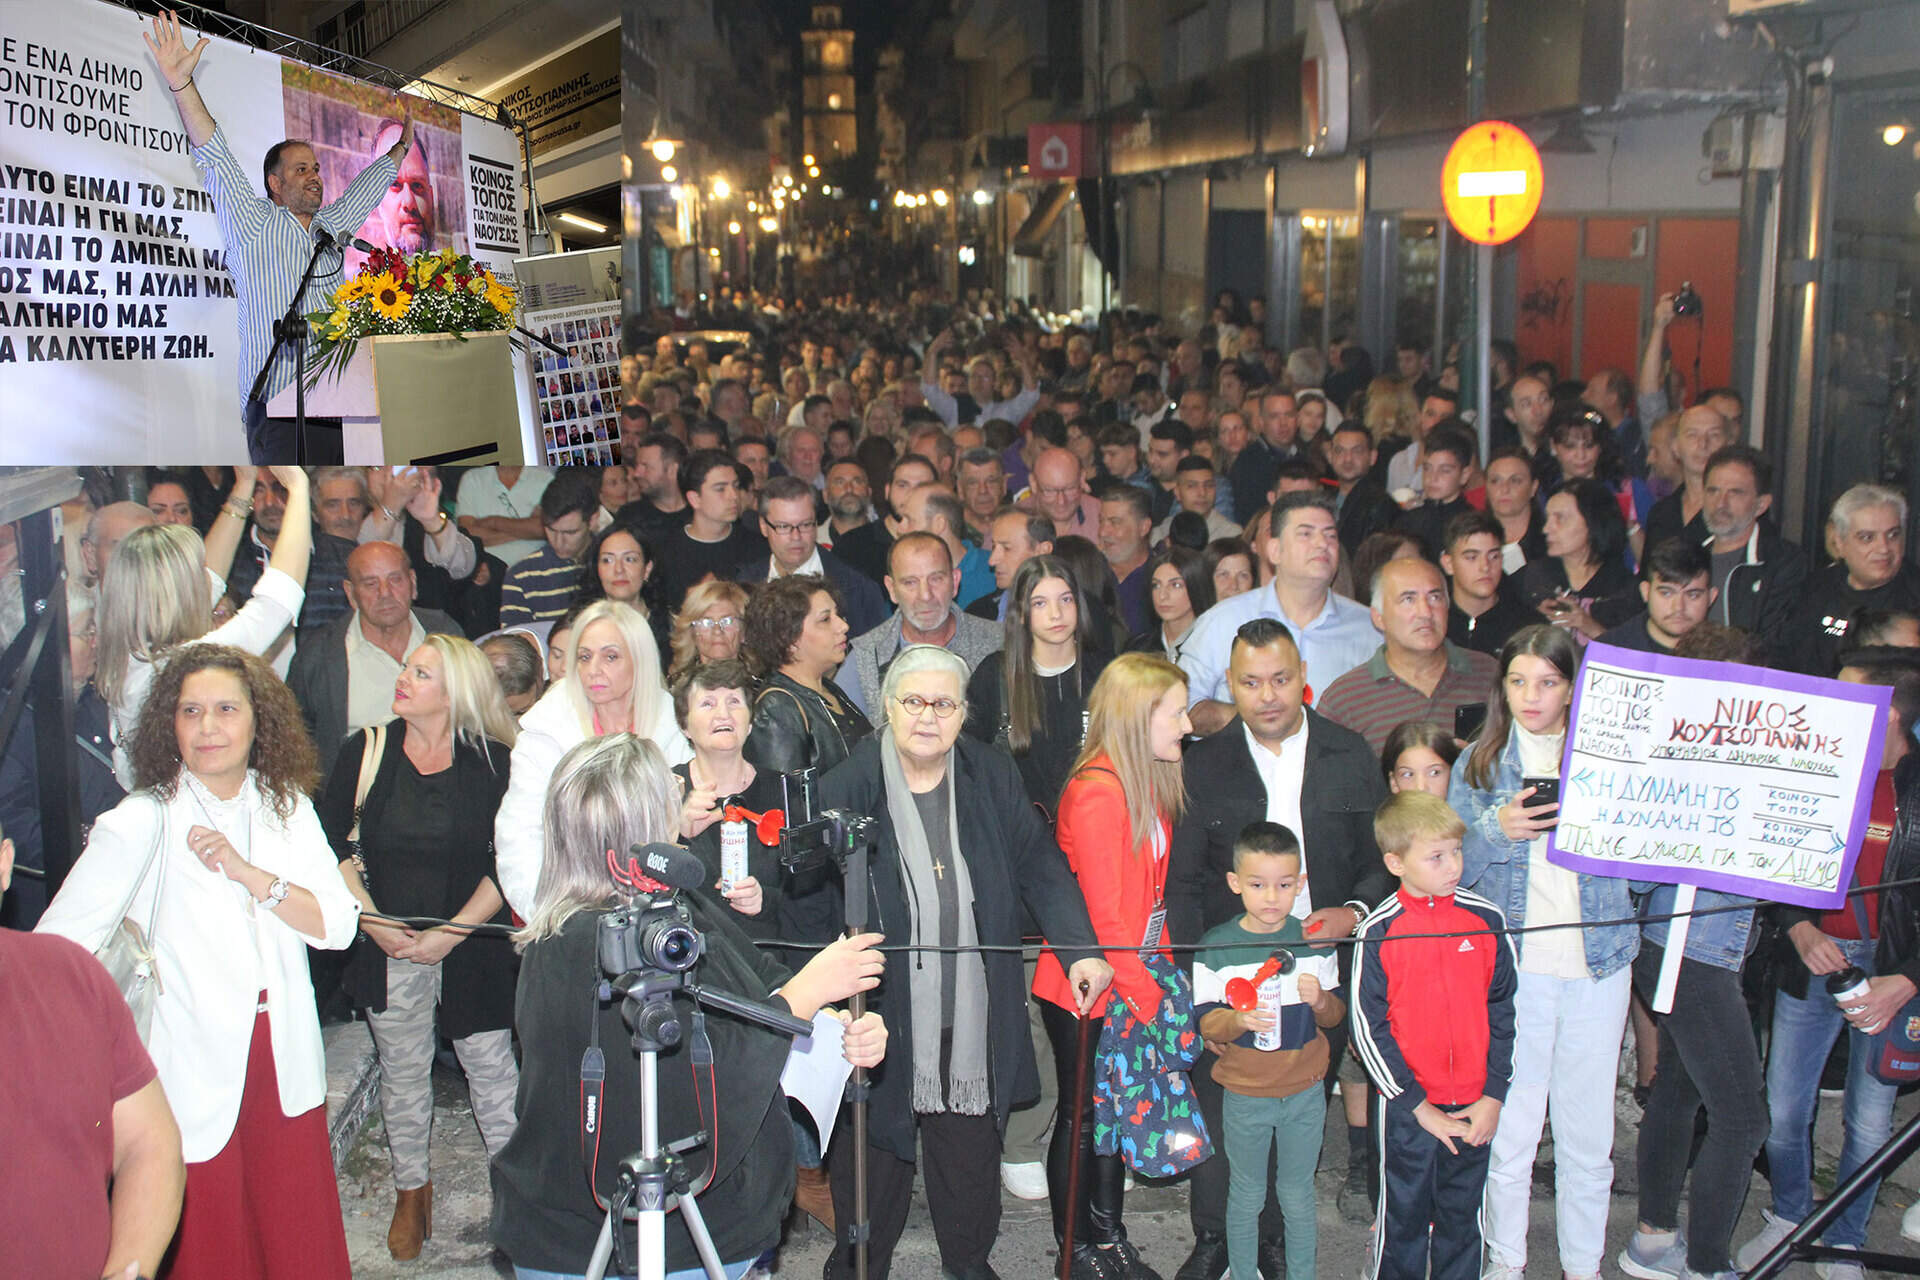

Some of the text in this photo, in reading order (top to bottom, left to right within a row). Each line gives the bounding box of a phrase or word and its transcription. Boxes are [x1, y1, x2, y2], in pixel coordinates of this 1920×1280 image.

[26, 43, 72, 76] ΕΝΑ
[80, 58, 143, 91] ΔΗΜΟ
[0, 67, 130, 117] ΟΝΤΙΣΟΥΜΕ
[501, 85, 532, 108] ΝΙΚΟΣ
[510, 72, 592, 119] ΟΥΤΣΟΓΙΑΝΝΗΣ
[4, 100, 54, 132] ΤΟΝ
[64, 174, 130, 205] ΕΙΝΑΙ
[138, 182, 165, 209] ΤΟ
[470, 165, 515, 193] ΚΟΙΝΟΣ
[472, 185, 516, 213] ΤΟΠΟΣ
[75, 205, 91, 229] Η
[99, 209, 128, 234] ΓΗ
[135, 213, 189, 243] ΜΑΣ,
[473, 208, 517, 226] ΓΙΑ ΤΟΝ ΔΗΜΟ
[474, 222, 519, 243] ΝΑΟΥΣΑΣ
[0, 232, 62, 261] ΙΝΑΙ
[72, 236, 103, 263] ΤΟ
[110, 240, 197, 269] ΑΜΠΕΛΙ
[42, 269, 107, 299] ΜΑΣ,
[116, 272, 132, 296] Η
[140, 272, 197, 297] ΑΥΛΗ
[204, 276, 238, 299] ΜΑ
[117, 304, 168, 328] ΜΑΣ
[27, 335, 156, 362] ΚΑΛΥΤΕΡΗ
[163, 335, 214, 359] ΖΩΗ.
[1590, 672, 1664, 702] ΚΟΙΝΟΣ
[1586, 694, 1653, 722] ΤΟΠΟΣ
[1714, 698, 1810, 732] ΝΙΚΟΣ
[1669, 717, 1844, 758] ΚΟΥΤΣΟΓΙΑΝΝΗΣ
[1617, 774, 1708, 808] ΔΥΝΑΜΗ
[1769, 789, 1821, 805] ΚΟΙΝΟΥ
[1592, 805, 1608, 822] Η
[1612, 809, 1701, 832] ΔΥΝΑΜΗ
[1766, 803, 1819, 818] ΤΟΠΟΥ
[1763, 822, 1813, 837] ΚΟΙΝΟΥ
[1712, 848, 1737, 867] ΓΙΑ
[1768, 850, 1840, 889] ΔΗΜΟ
